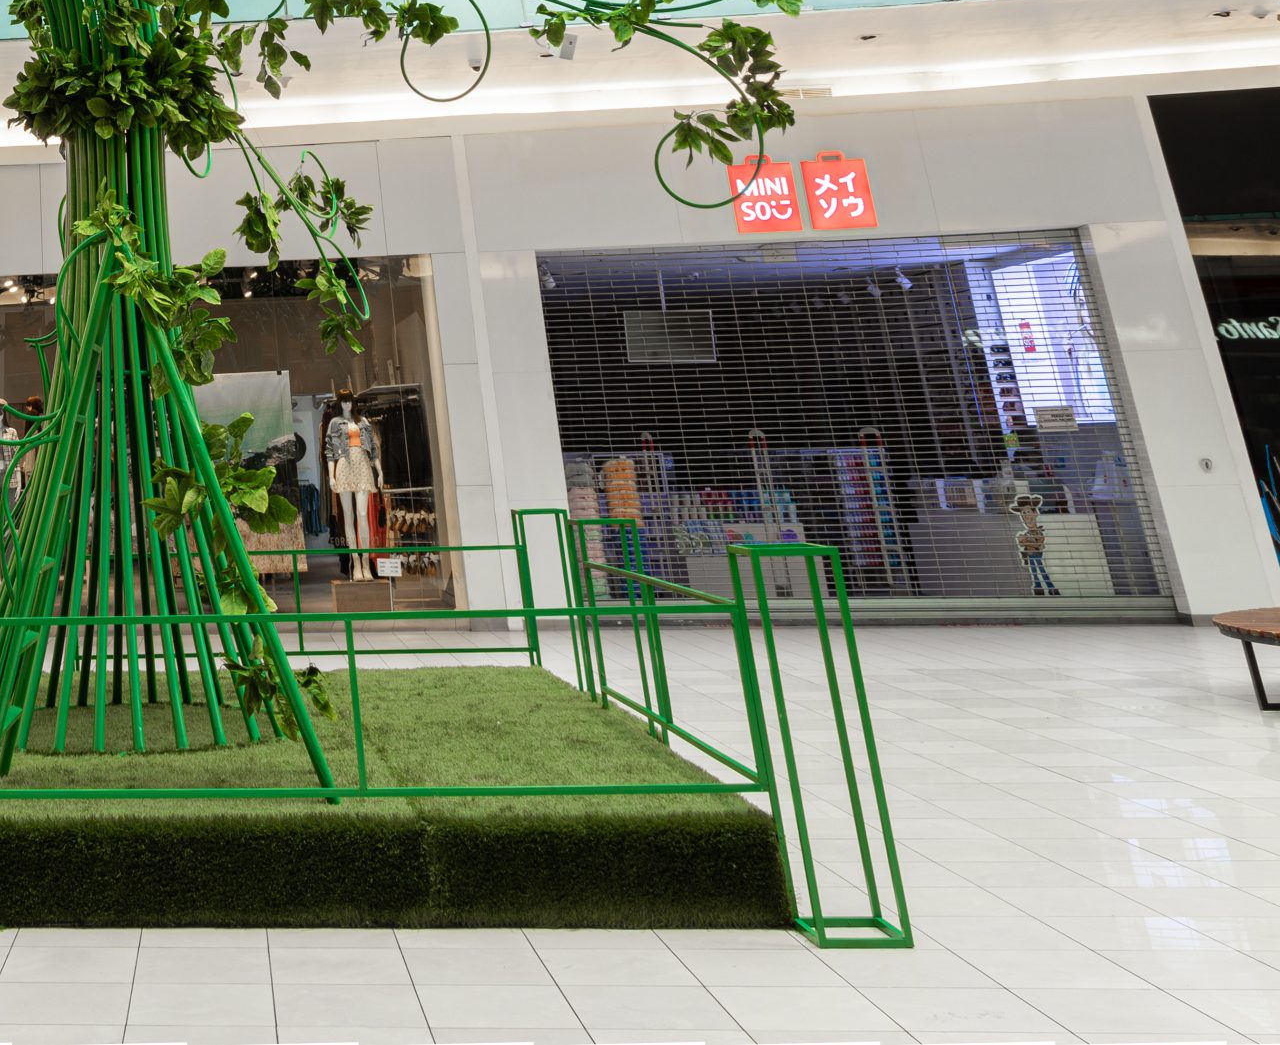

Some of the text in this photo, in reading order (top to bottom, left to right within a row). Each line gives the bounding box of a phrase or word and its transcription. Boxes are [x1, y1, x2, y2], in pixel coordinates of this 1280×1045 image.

[736, 177, 789, 197] MINI
[815, 172, 856, 196] メイ
[819, 196, 864, 218] ソウ
